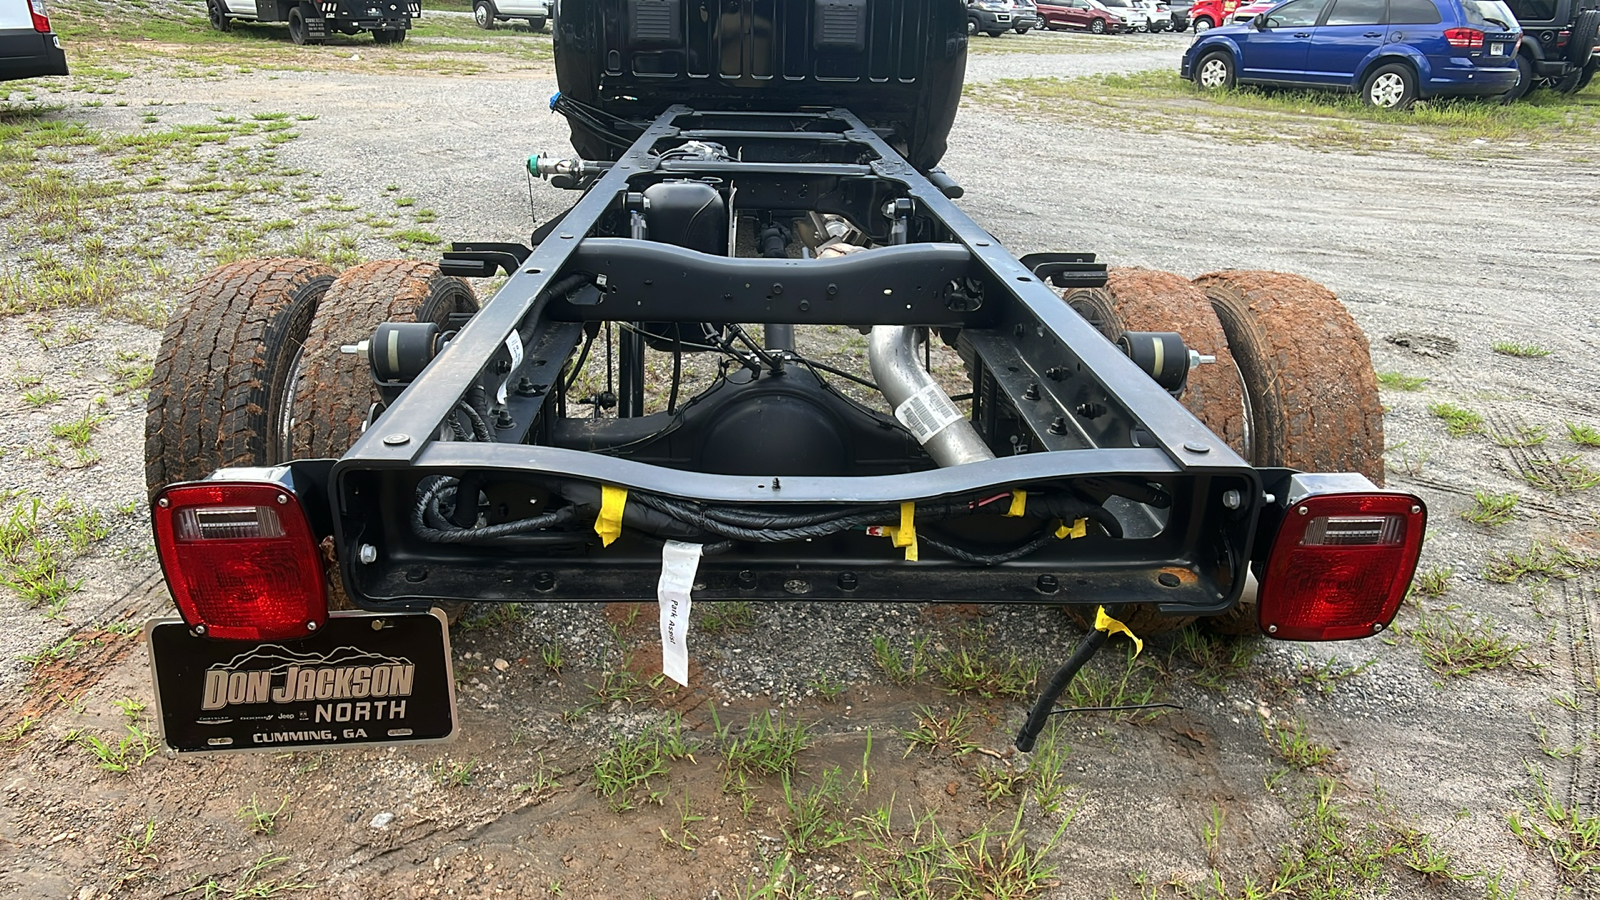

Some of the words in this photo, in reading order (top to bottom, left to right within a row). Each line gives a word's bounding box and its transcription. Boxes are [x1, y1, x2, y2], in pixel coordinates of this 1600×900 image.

[668, 620, 676, 645] Assist
[202, 669, 271, 710] DON
[272, 664, 414, 703] JACKSON
[315, 700, 406, 723] NORTH
[252, 730, 338, 743] CUMMING,
[343, 728, 368, 739] GA
